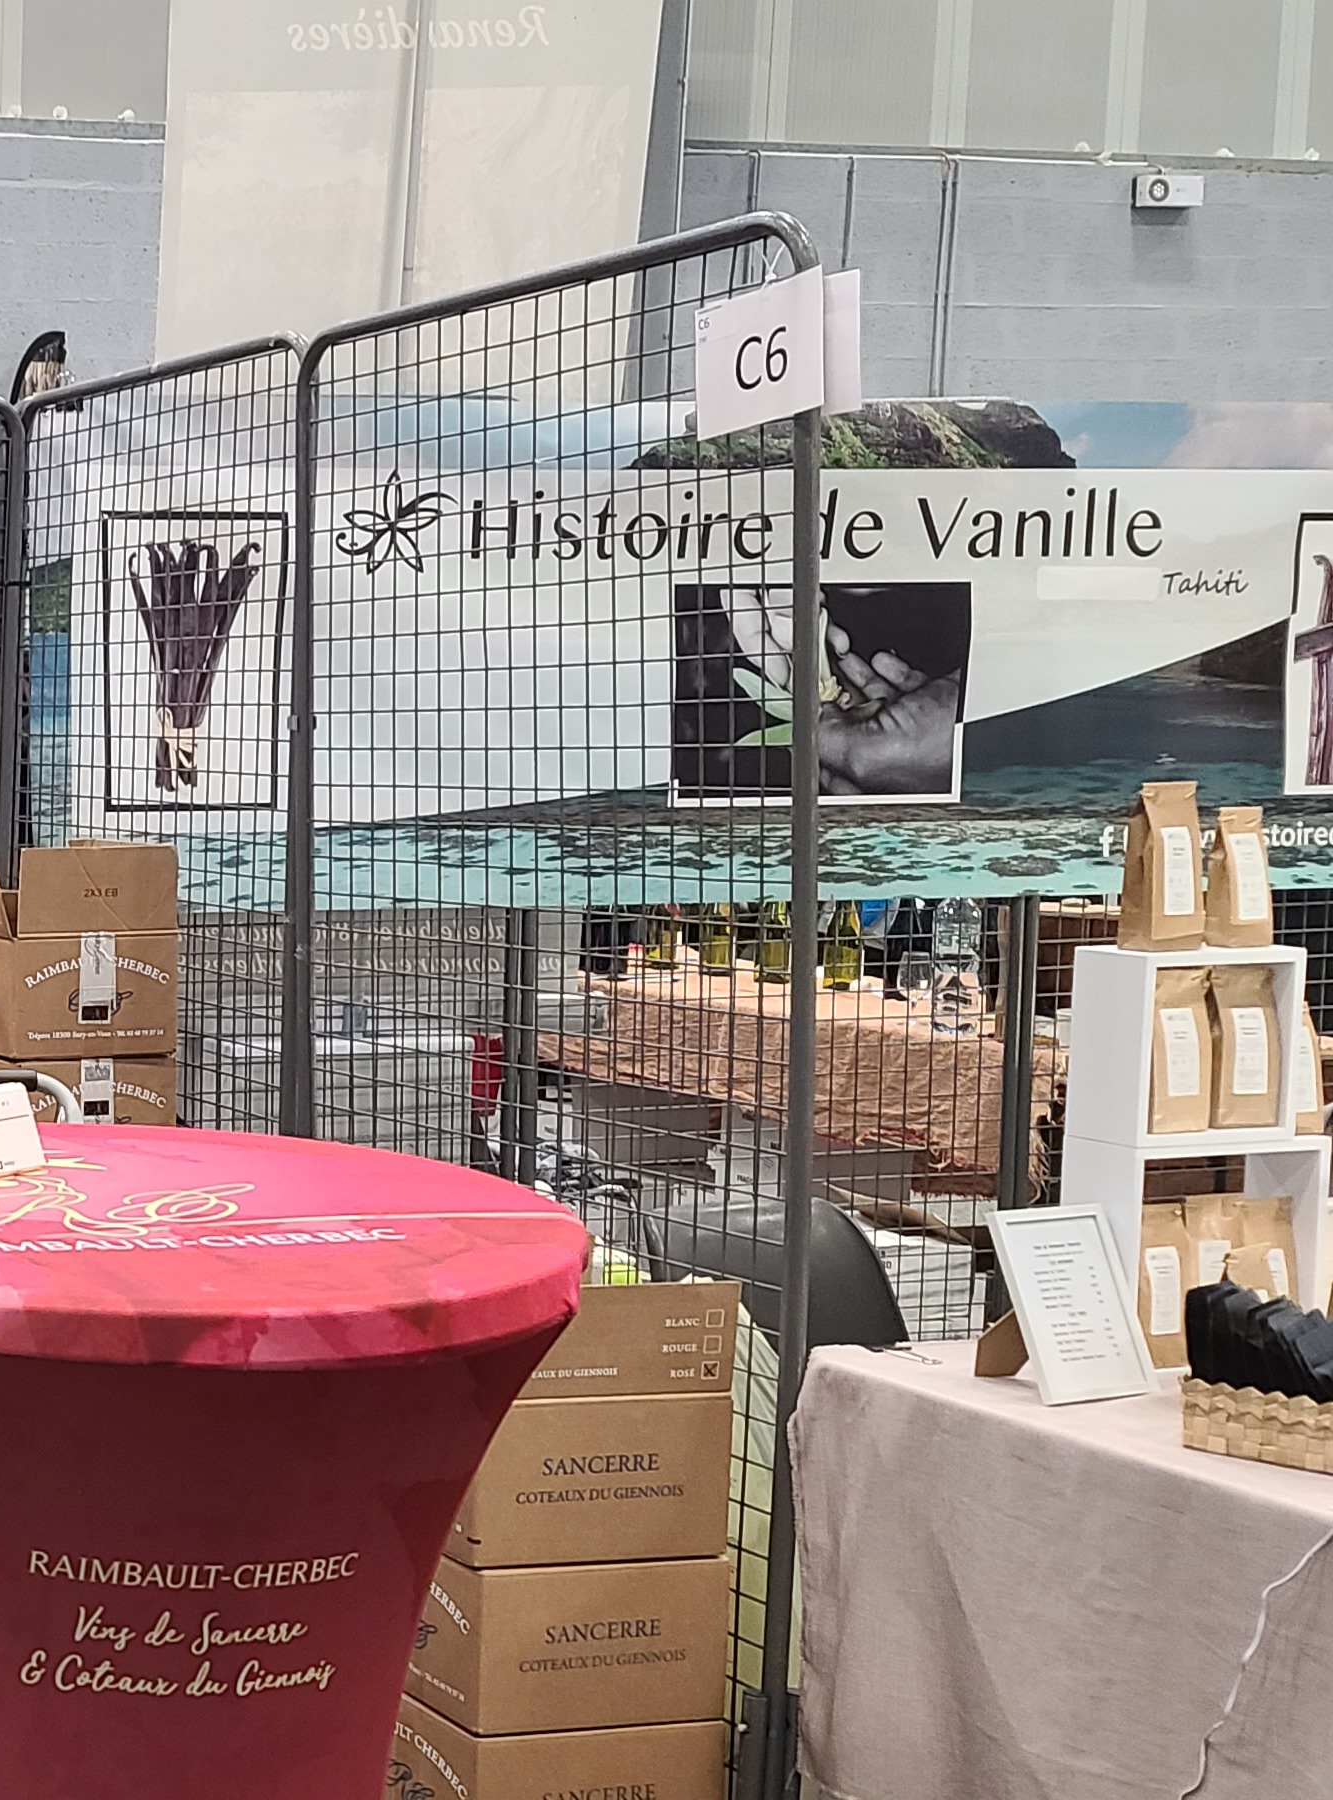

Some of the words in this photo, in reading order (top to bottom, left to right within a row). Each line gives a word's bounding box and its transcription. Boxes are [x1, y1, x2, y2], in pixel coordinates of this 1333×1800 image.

[698, 317, 710, 331] C6
[735, 326, 788, 391] C6
[471, 490, 774, 561] Histoire
[917, 487, 1164, 560] Vanille
[1163, 569, 1250, 596] Tahiti
[665, 1317, 700, 1328] BLANC
[661, 1343, 698, 1353] ROUGE
[558, 1368, 572, 1378] DU
[573, 1367, 618, 1378] GIENNOIS
[670, 1366, 695, 1379] ROSÉ
[541, 1453, 660, 1477] SANCERRE
[515, 1488, 585, 1505] COTEAUX
[589, 1486, 611, 1501] DU
[613, 1484, 684, 1500] GIENNOIS
[28, 1549, 360, 1590] RAIMBAULT-CHERBEC
[73, 1605, 137, 1652] Vins
[144, 1611, 184, 1647] de
[191, 1612, 309, 1656] Sancerre
[545, 1618, 661, 1645] SANCERRE
[19, 1648, 47, 1686] &
[54, 1653, 179, 1697] Coteaux
[185, 1661, 228, 1698] du
[235, 1658, 336, 1698] Giennois
[519, 1657, 588, 1673] COTEAUX
[591, 1655, 614, 1668] DU
[616, 1648, 686, 1667] GIENNOIS
